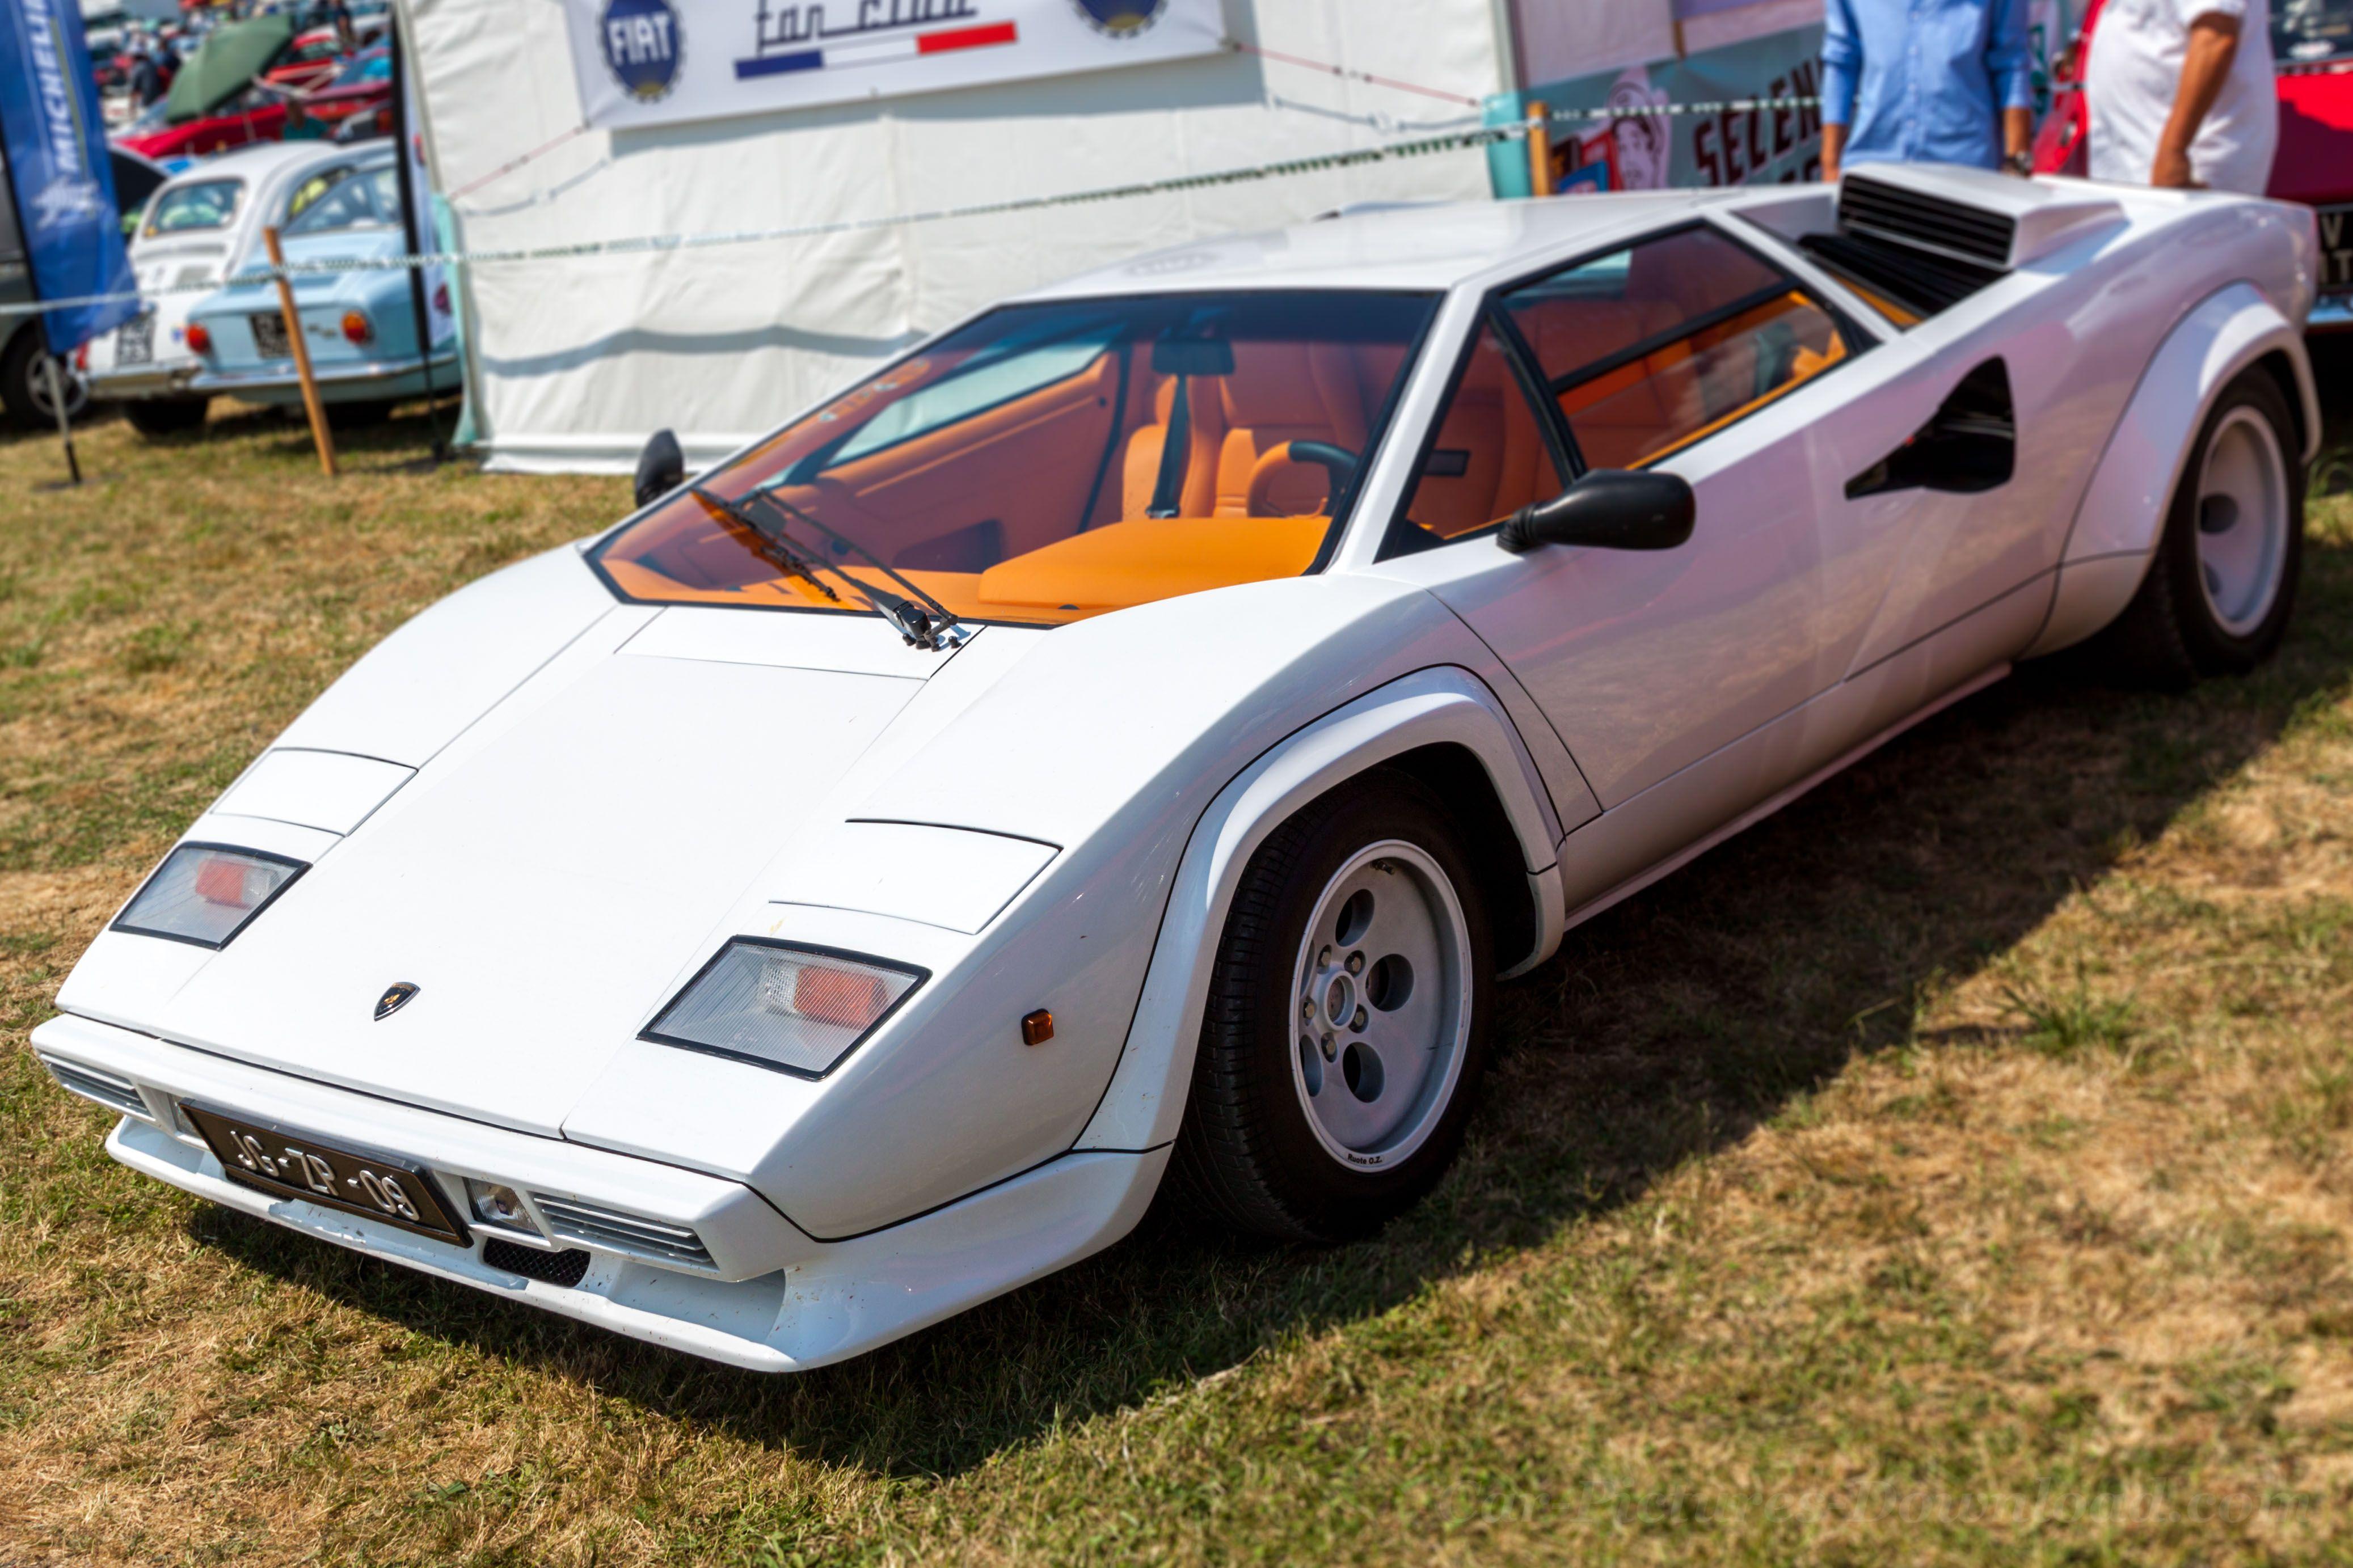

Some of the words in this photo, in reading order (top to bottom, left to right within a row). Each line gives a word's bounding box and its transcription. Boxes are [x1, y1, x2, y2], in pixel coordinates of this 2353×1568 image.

[609, 11, 671, 66] FIAT
[230, 1130, 420, 1221] JG-ZP-09
[1348, 1153, 1367, 1164] Ruote
[1368, 1156, 1382, 1164] O.Z.
